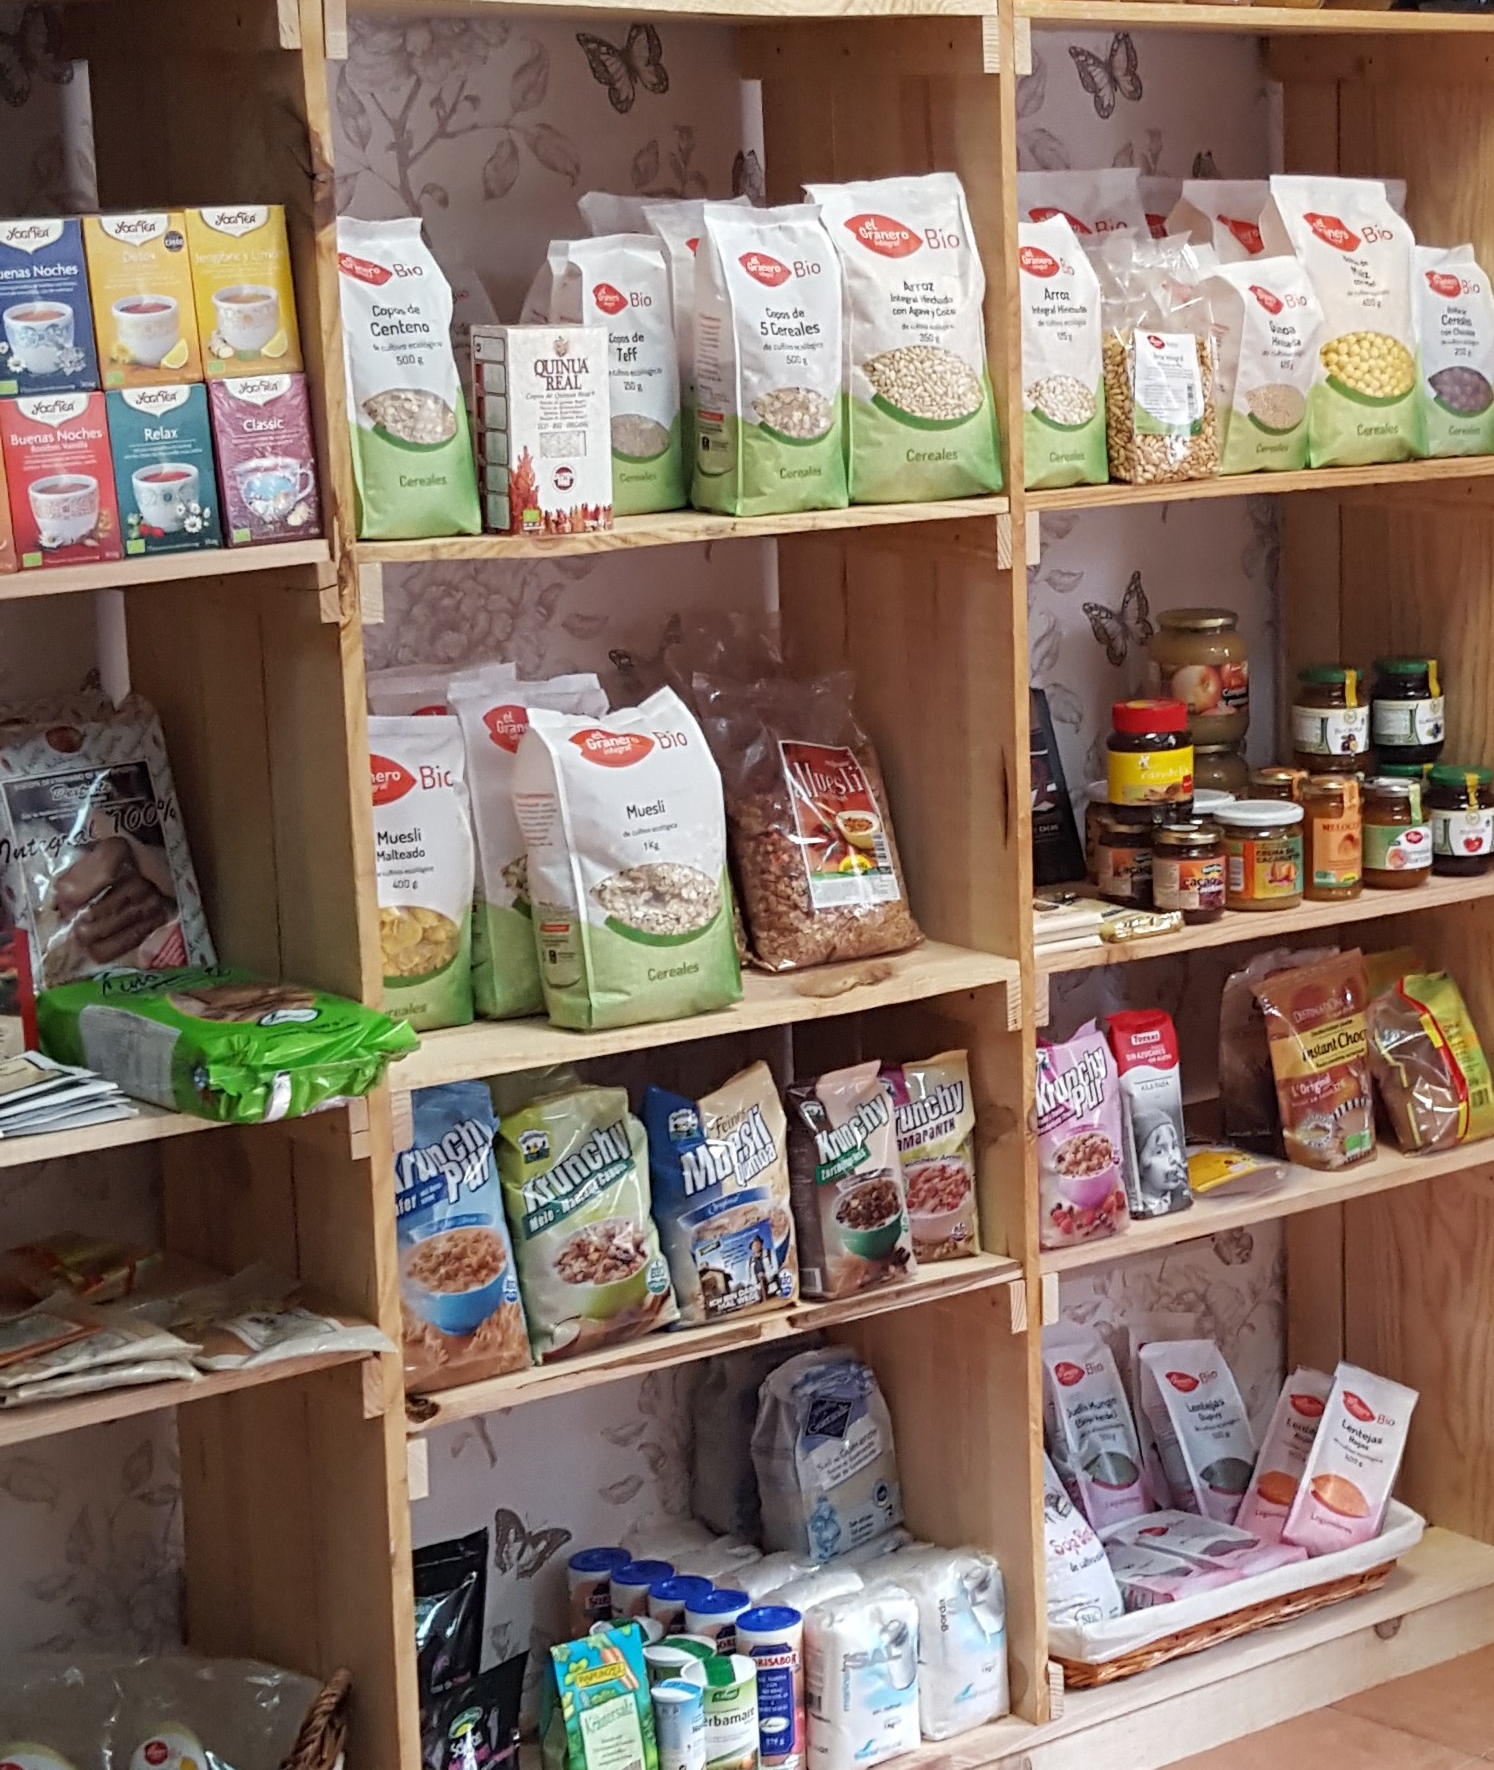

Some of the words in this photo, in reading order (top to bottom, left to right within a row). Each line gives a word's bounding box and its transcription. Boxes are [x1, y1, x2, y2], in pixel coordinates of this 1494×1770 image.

[923, 228, 960, 250] Bio
[1360, 224, 1394, 245] Bio
[33, 264, 79, 278] Noches
[393, 263, 423, 278] Bio
[793, 261, 821, 278] Bio
[902, 279, 935, 292] Arroz
[629, 292, 652, 308] Bio
[371, 304, 405, 320] Copos
[369, 321, 430, 338] Centeno
[760, 322, 769, 336] 5
[770, 322, 821, 338] Cereales
[616, 348, 638, 363] Teff
[534, 356, 589, 379] QUINUA
[545, 375, 583, 392] REAL
[242, 417, 285, 432] Classic
[10, 432, 56, 447] Buenas
[56, 428, 102, 444] Noches
[143, 428, 178, 442] Relax
[905, 447, 959, 464] Cereales
[399, 476, 447, 489] Cereales
[655, 729, 689, 750] Bio
[792, 761, 865, 800] Muesli
[111, 797, 177, 834] 100%
[625, 800, 667, 821] Muesli
[376, 827, 423, 846] Muesli
[376, 850, 426, 863] Malteado
[647, 962, 701, 982] Cereales
[1036, 1045, 1108, 1121] Krunchy
[816, 1093, 890, 1166] Krunchy
[523, 1119, 634, 1215] Krunchy
[1341, 1418, 1384, 1446] Lentejas
